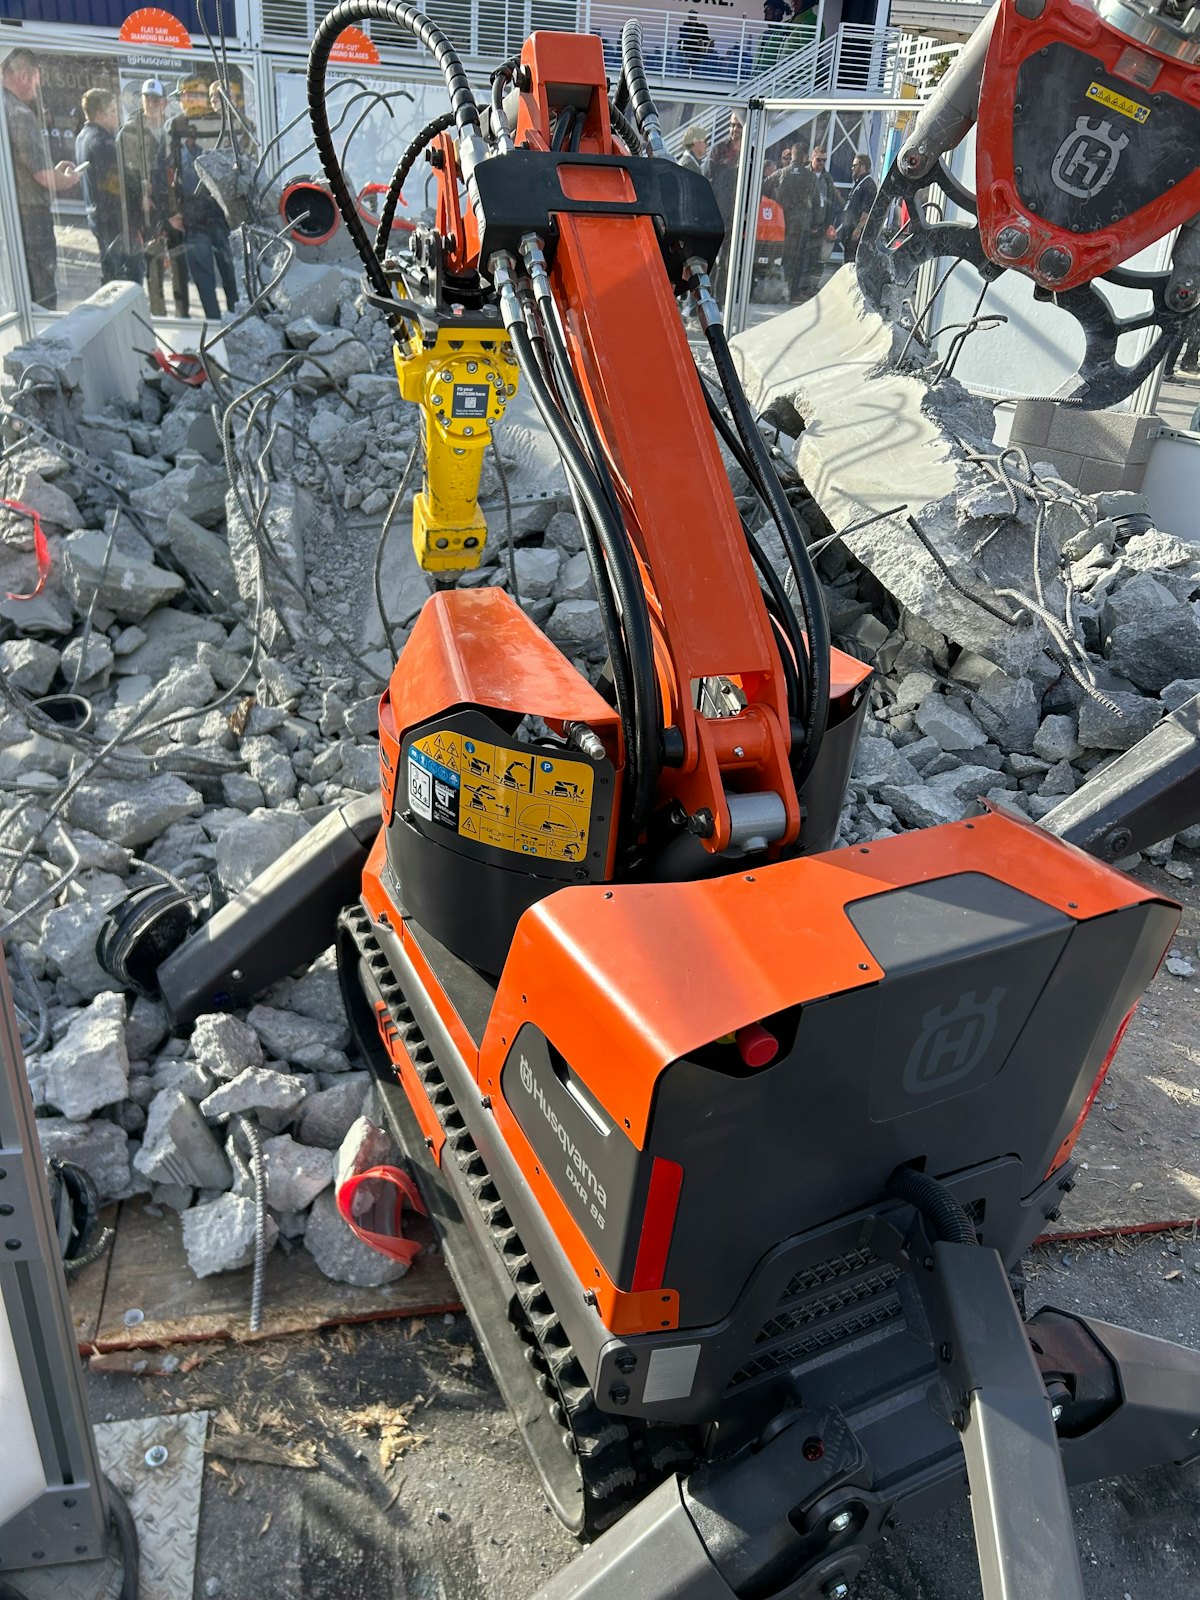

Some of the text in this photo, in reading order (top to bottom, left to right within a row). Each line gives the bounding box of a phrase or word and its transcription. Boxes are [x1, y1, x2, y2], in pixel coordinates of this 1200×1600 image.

[141, 26, 168, 35] FLAT SAW
[130, 33, 180, 43] DIAMOND BLADES
[137, 55, 182, 67] Husqvarna
[349, 51, 369, 59] BLADES
[413, 779, 422, 799] 94
[534, 1078, 607, 1210] Husqvarna
[566, 1165, 606, 1230] DXR 95
